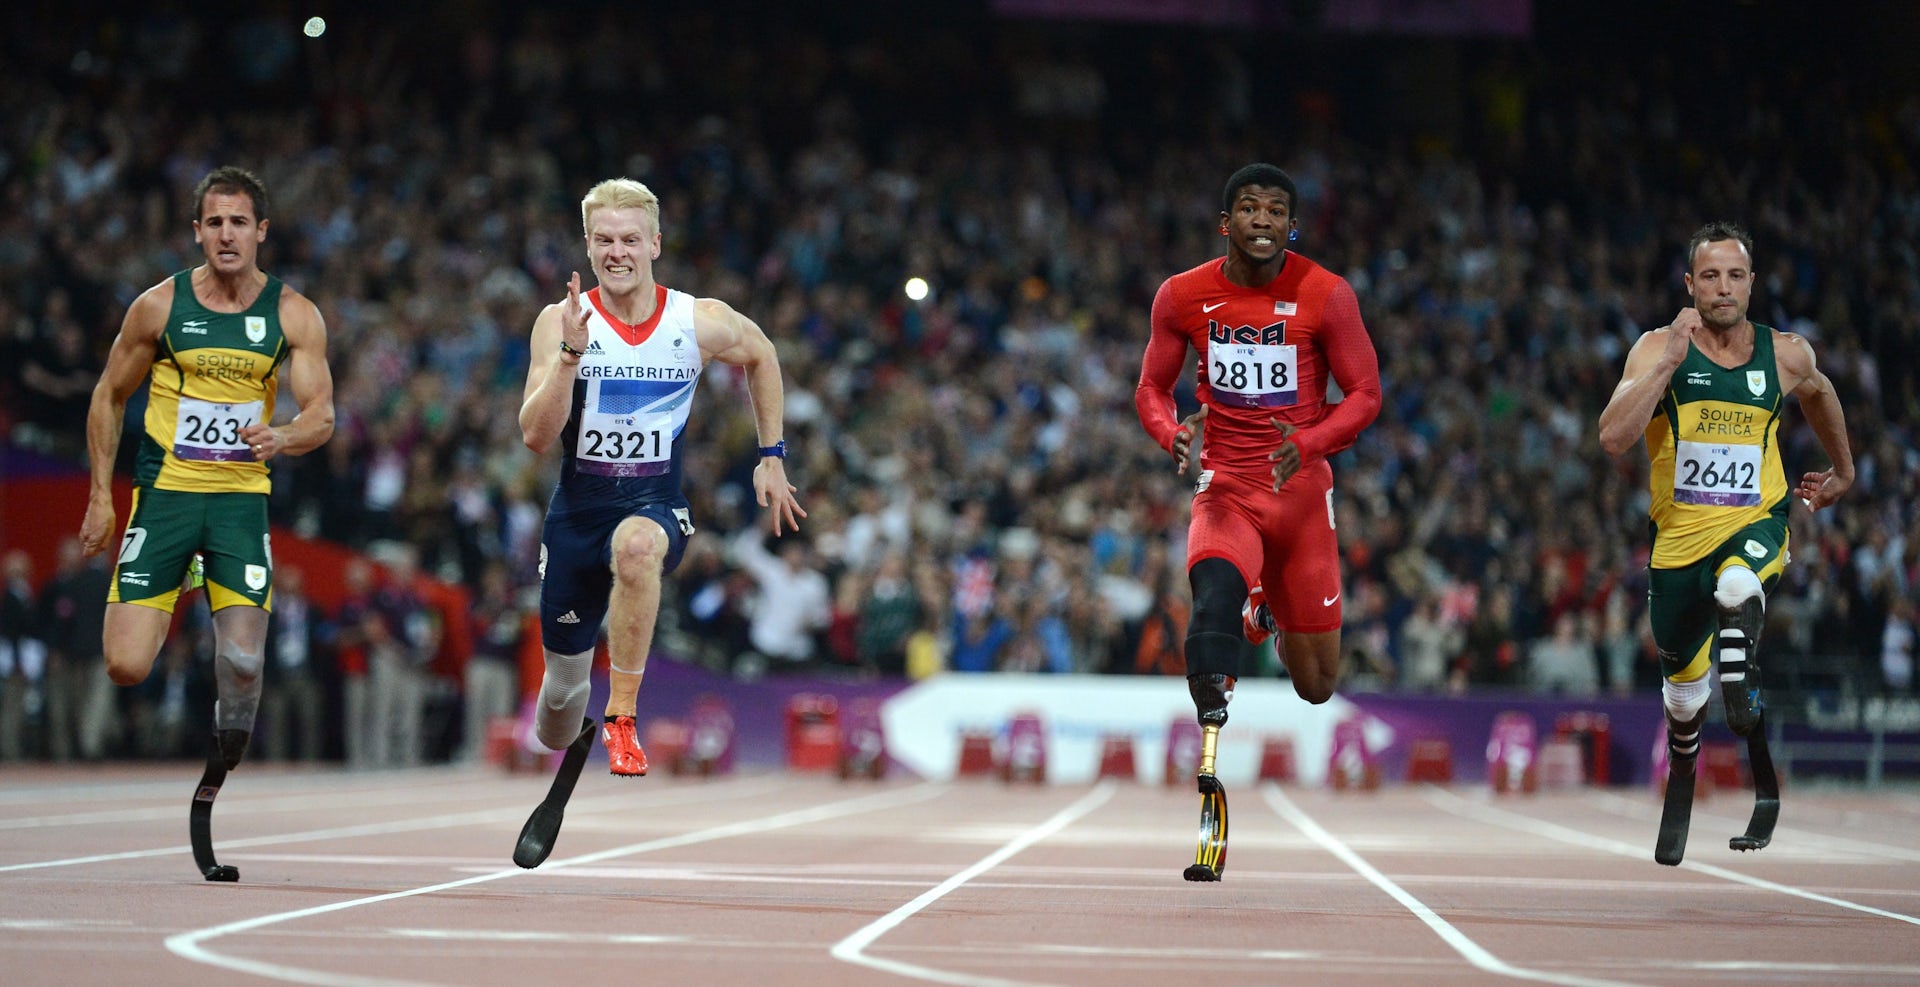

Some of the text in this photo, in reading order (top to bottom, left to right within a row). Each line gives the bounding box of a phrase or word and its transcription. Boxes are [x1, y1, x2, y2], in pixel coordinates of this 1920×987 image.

[1209, 319, 1286, 346] USA
[196, 355, 255, 370] SOUTH
[196, 368, 252, 380] AFRICA
[1215, 361, 1288, 389] 2818
[1687, 378, 1712, 386] ERKE
[1700, 408, 1754, 423] SOUTH
[1695, 421, 1752, 436] AFRICA
[584, 429, 660, 459] 2321
[1682, 459, 1755, 489] 2642
[119, 533, 136, 560] 7
[120, 576, 150, 587] ERKE
